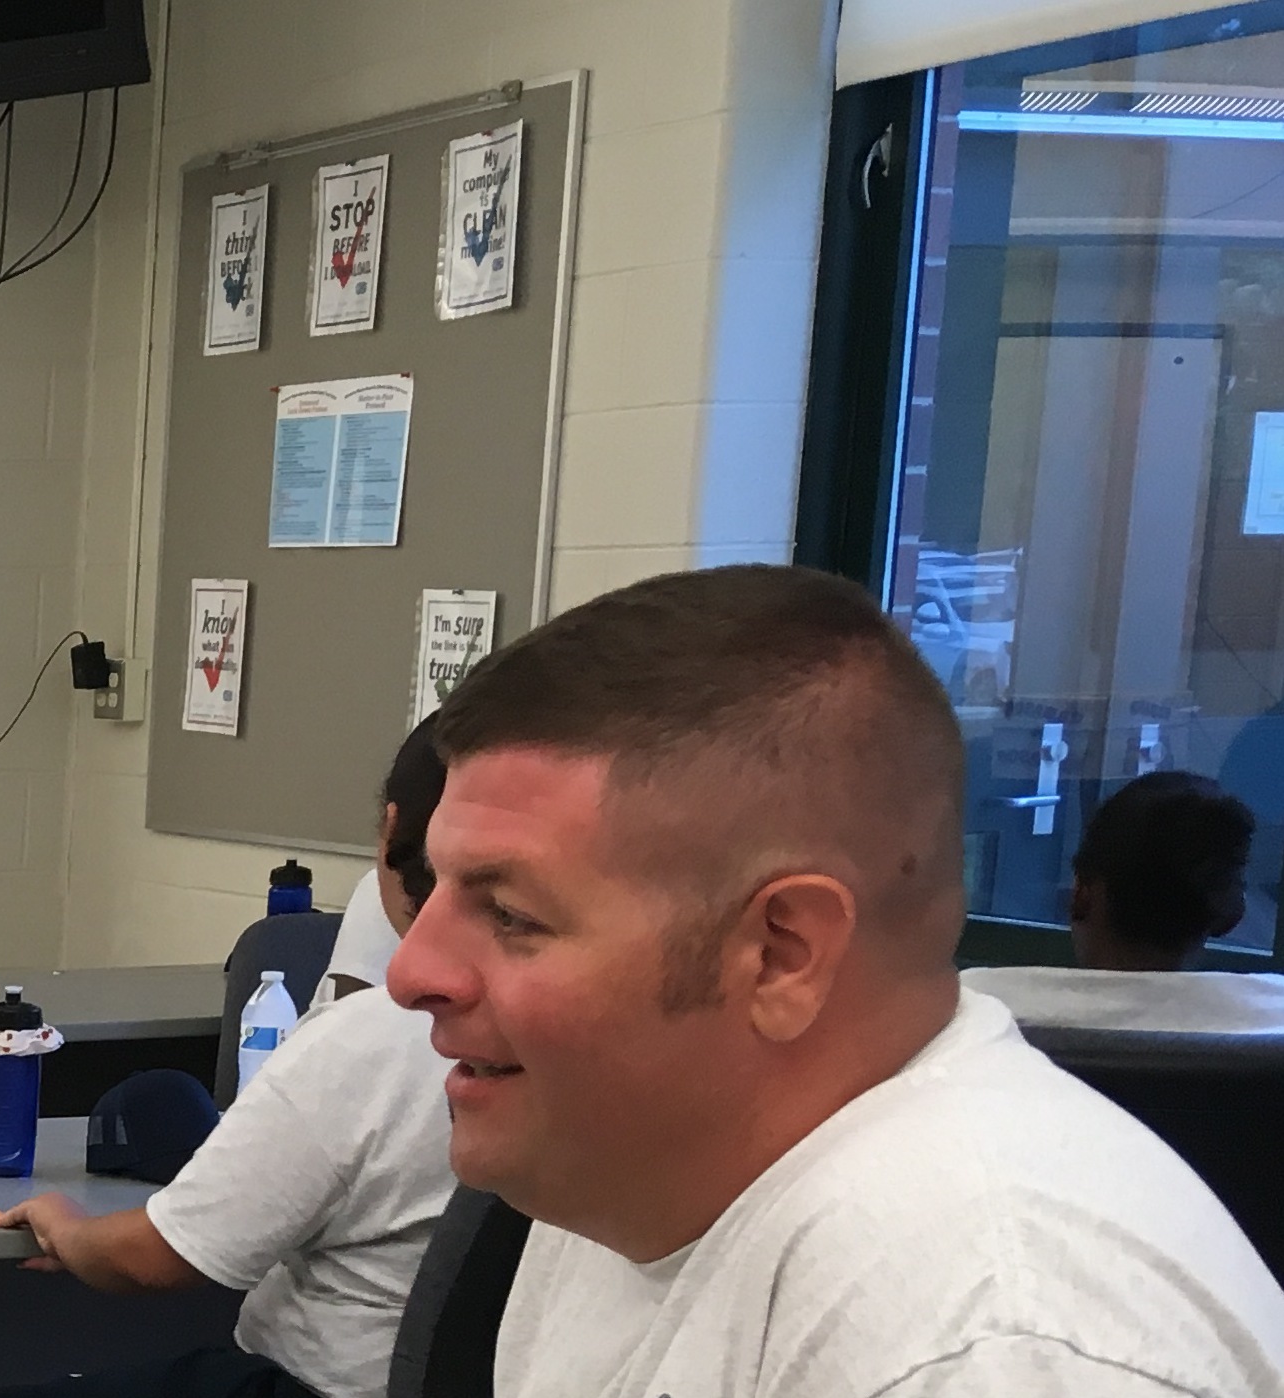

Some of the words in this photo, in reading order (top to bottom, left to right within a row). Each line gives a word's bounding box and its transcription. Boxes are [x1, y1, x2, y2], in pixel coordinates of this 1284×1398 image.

[483, 149, 499, 170] My
[352, 180, 359, 197] I
[242, 209, 248, 226] I
[329, 198, 376, 232] STOP
[220, 599, 226, 615] I
[434, 614, 451, 632] I'm
[453, 615, 484, 636] sure
[431, 640, 442, 651] the
